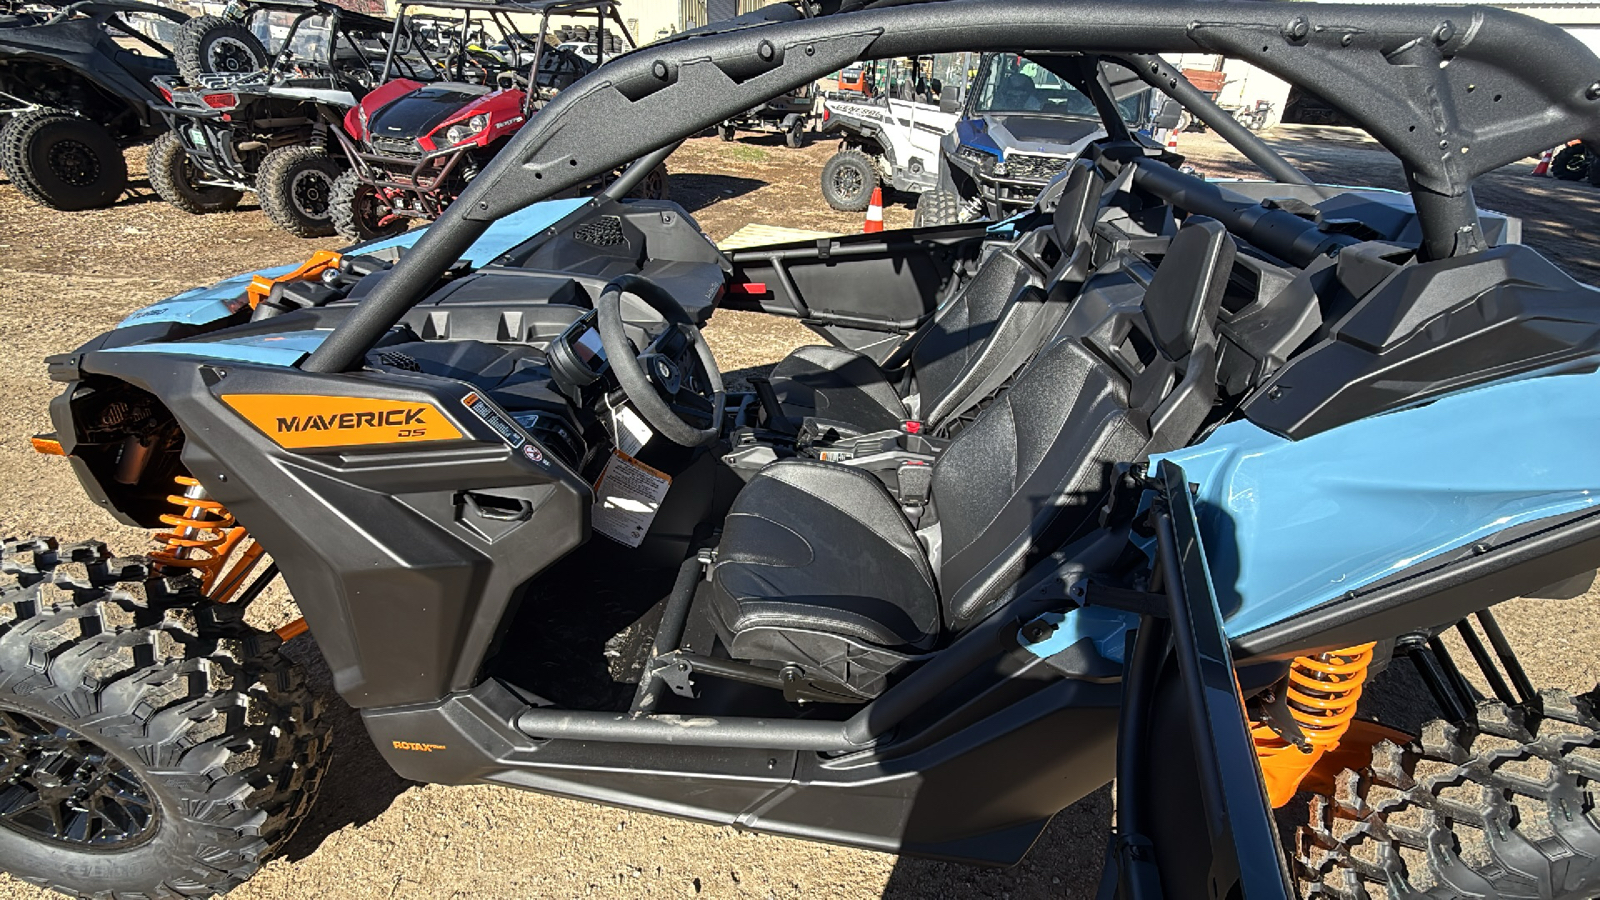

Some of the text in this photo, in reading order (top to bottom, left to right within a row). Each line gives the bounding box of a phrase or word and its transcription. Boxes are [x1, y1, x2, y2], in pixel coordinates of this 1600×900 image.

[276, 407, 427, 433] MAVERICK
[398, 428, 427, 438] DS
[392, 741, 433, 752] ROTAX
